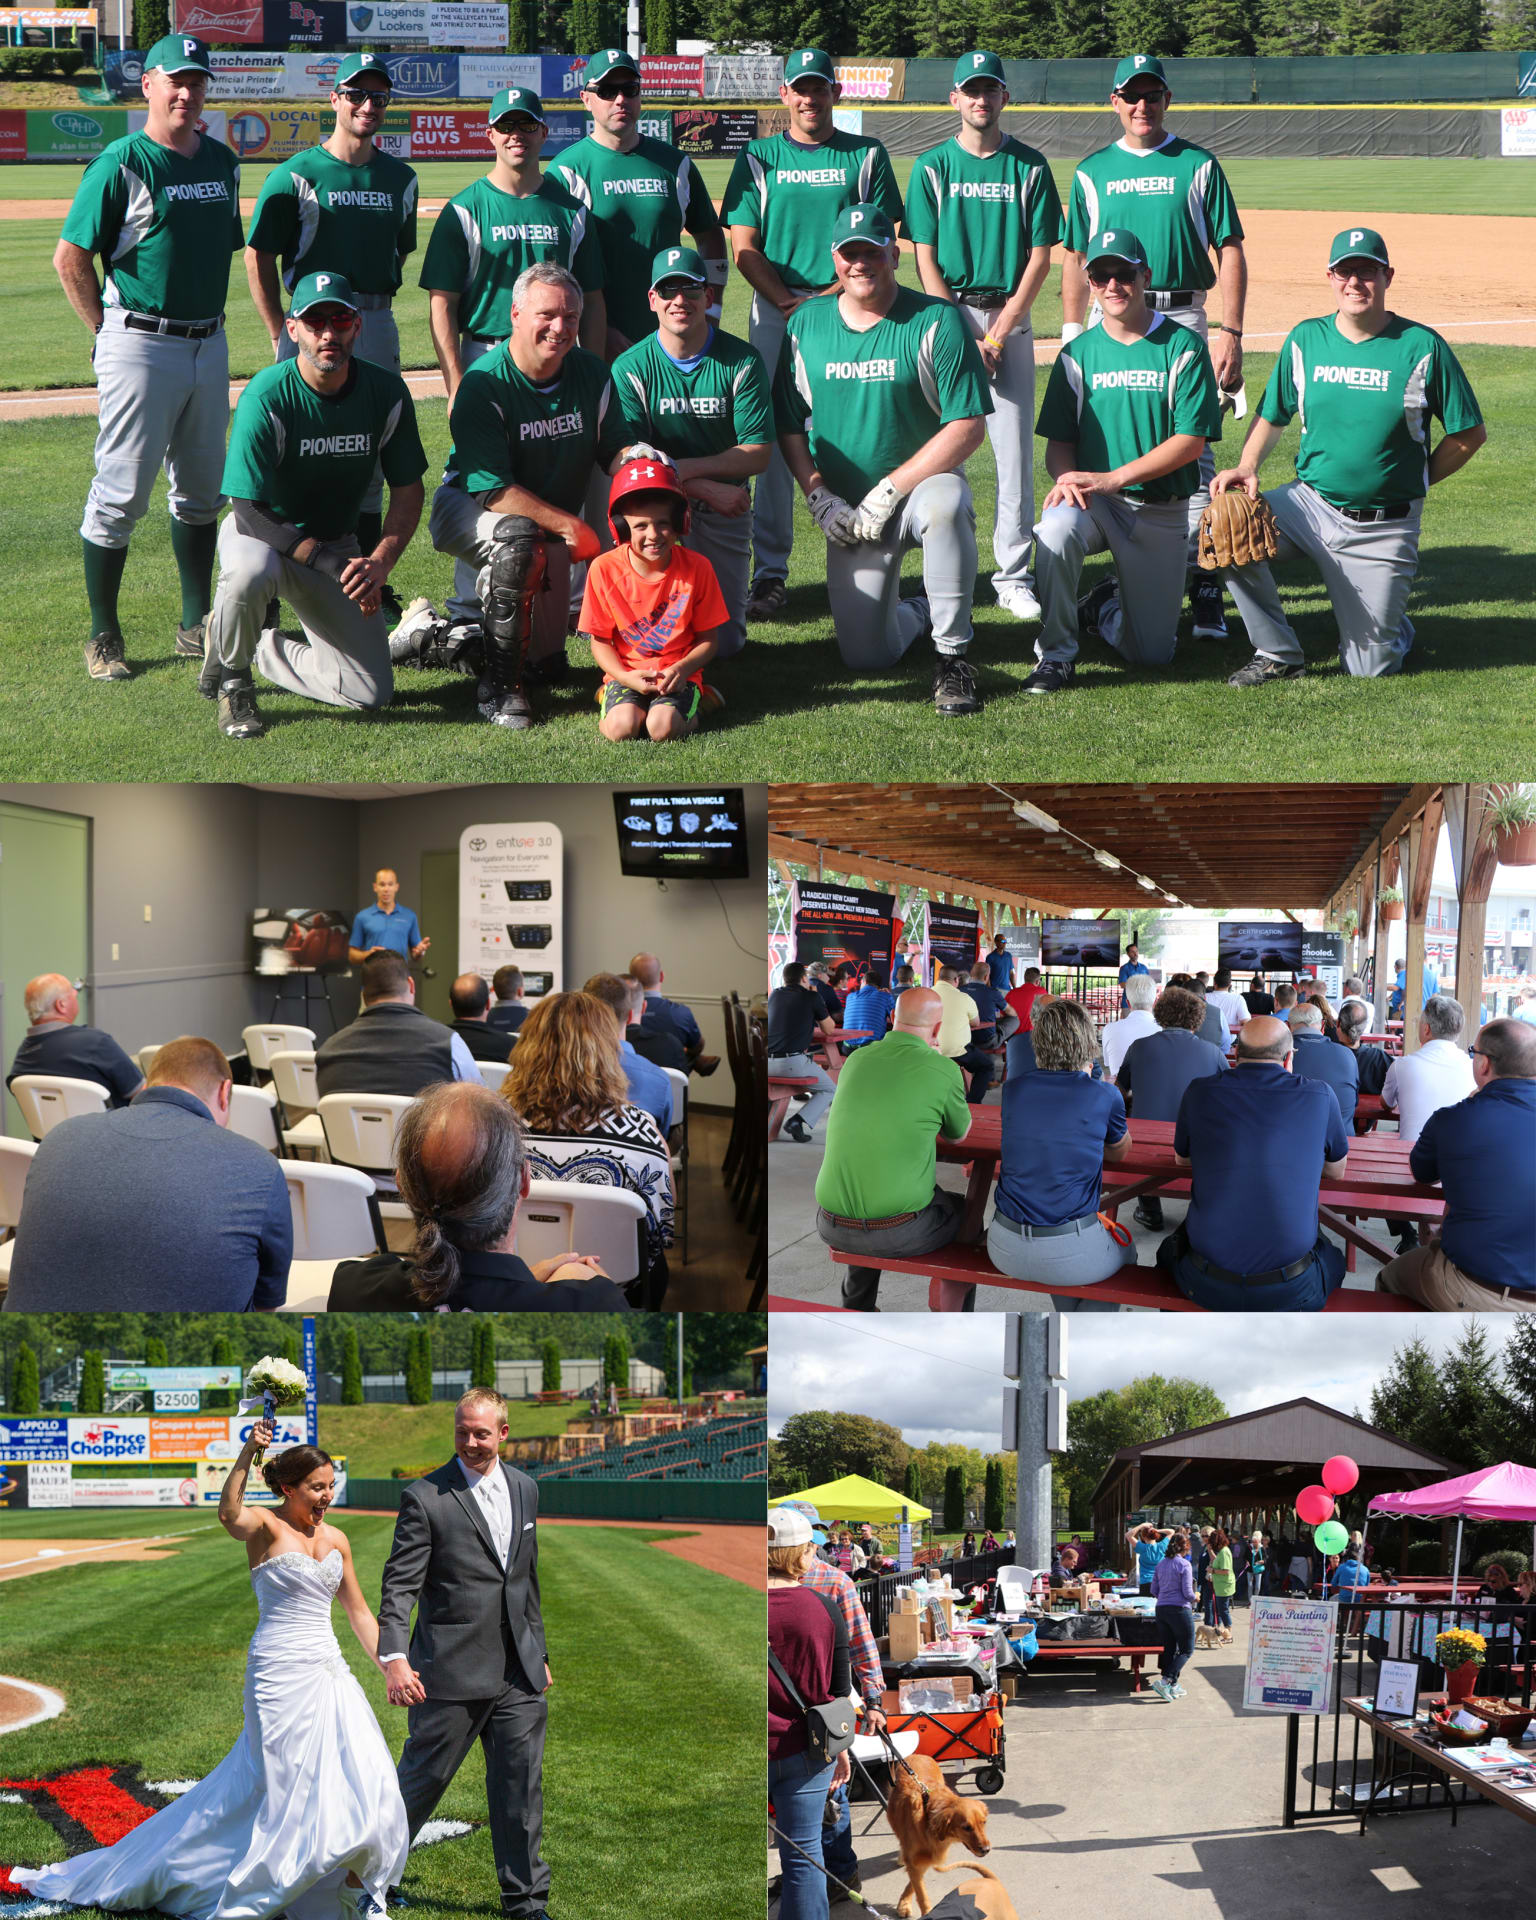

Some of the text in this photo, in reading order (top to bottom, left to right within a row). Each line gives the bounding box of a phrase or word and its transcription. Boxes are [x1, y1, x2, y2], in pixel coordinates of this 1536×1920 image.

[189, 12, 252, 27] Budweiser
[289, 2, 324, 33] RPI
[377, 7, 425, 19] Legends
[379, 21, 424, 31] Lockers
[183, 40, 197, 56] P
[210, 55, 286, 66] enchemark
[361, 53, 374, 66] P
[607, 50, 620, 64] P
[802, 52, 815, 66] P
[973, 54, 986, 68] P
[1134, 55, 1147, 69] P
[398, 61, 444, 83] GTM
[502, 64, 537, 72] GAZETTE
[640, 61, 700, 73] @ValleyCats
[246, 75, 278, 84] Printer
[721, 72, 782, 81] ALEX DELL
[834, 67, 893, 82] UNKIN'
[216, 86, 230, 94] the
[233, 86, 286, 95] ValleyCats!
[508, 89, 521, 104] P
[841, 82, 890, 97] NUTS
[270, 111, 319, 122] LOCAL
[416, 115, 456, 129] FIVE
[674, 110, 718, 128] IBEW
[288, 123, 301, 139] 7
[412, 131, 461, 145] GUYS
[60, 142, 76, 151] plan
[78, 141, 89, 149] for
[777, 168, 840, 184] PIONEER
[164, 181, 223, 203] PIONEER
[603, 178, 662, 196] PIONEER
[950, 182, 1010, 199] PIONEER
[1106, 176, 1168, 196] PIONEER
[328, 190, 388, 207] PIONEER
[850, 211, 864, 228] P
[491, 224, 553, 243] PIONEER
[1102, 231, 1115, 248] P
[1349, 231, 1364, 247] P
[667, 250, 681, 266] P
[316, 275, 331, 292] P
[825, 358, 889, 380] PIONEER
[1092, 370, 1158, 391] PIONEER
[1313, 366, 1383, 387] PIONEER
[660, 397, 720, 415] PIONEER
[520, 413, 576, 442] PIONEER
[299, 433, 365, 457] PIONEER
[630, 797, 725, 806] FIRST FULL TNGA VEHICLE
[538, 836, 552, 847] 3.0
[470, 855, 505, 864] Navigation
[517, 853, 550, 863] Everyone
[806, 891, 832, 901] RADICALLY
[832, 893, 843, 902] NEW
[843, 895, 859, 904] CAMRY
[801, 900, 827, 909] DESERVES
[831, 903, 856, 912] RADICALLY
[855, 906, 865, 914] NEW
[801, 910, 812, 918] THE
[812, 911, 834, 920] ALL-NEW
[843, 913, 863, 922] PREMIUM
[1238, 928, 1283, 936] CERTIFICATION
[1302, 949, 1335, 957] chooled.
[305, 1332, 316, 1391] TRUSTCO
[155, 1393, 199, 1407] $2500
[18, 1420, 60, 1431] APPOLO
[152, 1420, 193, 1431] Compare
[307, 1403, 316, 1437] BANK
[103, 1430, 146, 1444] Price
[71, 1441, 146, 1457] Chopper
[32, 1464, 67, 1473] HANK
[31, 1477, 68, 1485] BAUER
[1258, 1608, 1328, 1623] Paw Painting
